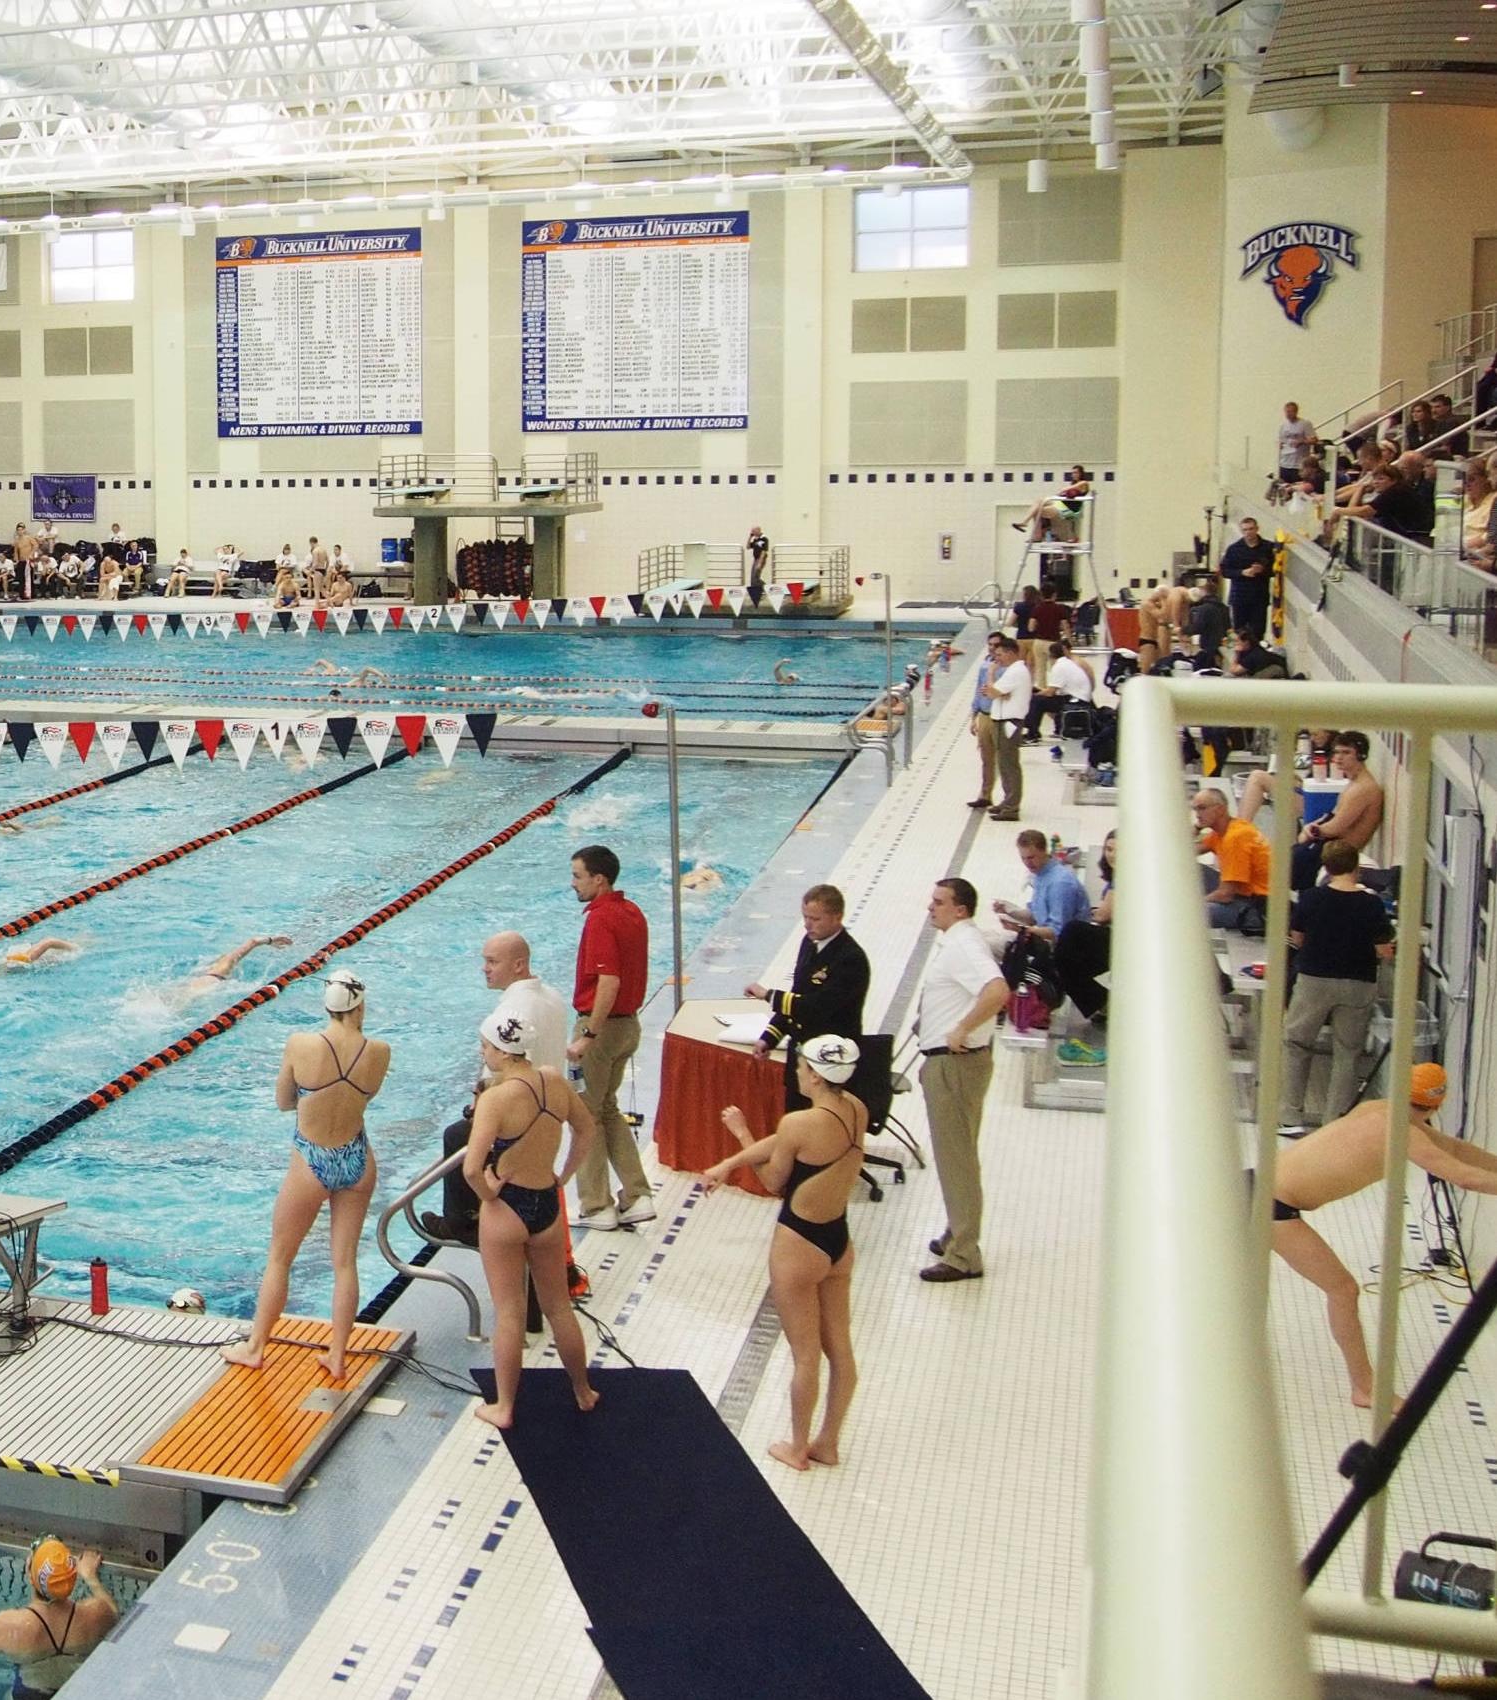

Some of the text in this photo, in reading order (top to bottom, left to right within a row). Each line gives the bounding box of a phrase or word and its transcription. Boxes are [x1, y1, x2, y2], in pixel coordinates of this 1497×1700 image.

[579, 219, 732, 240] BUCKNELL UNIVERSITY
[266, 235, 406, 255] BUCKNELL UNIVERSITY
[1244, 224, 1353, 269] BUCKNELL
[229, 423, 411, 436] MENS SWIMMING & DIVING RECORDS
[526, 417, 744, 431] WOMENS SWIMMING & DIVING RECORDS
[431, 607, 438, 618] 2
[205, 616, 212, 626] 3
[271, 722, 280, 741] 1
